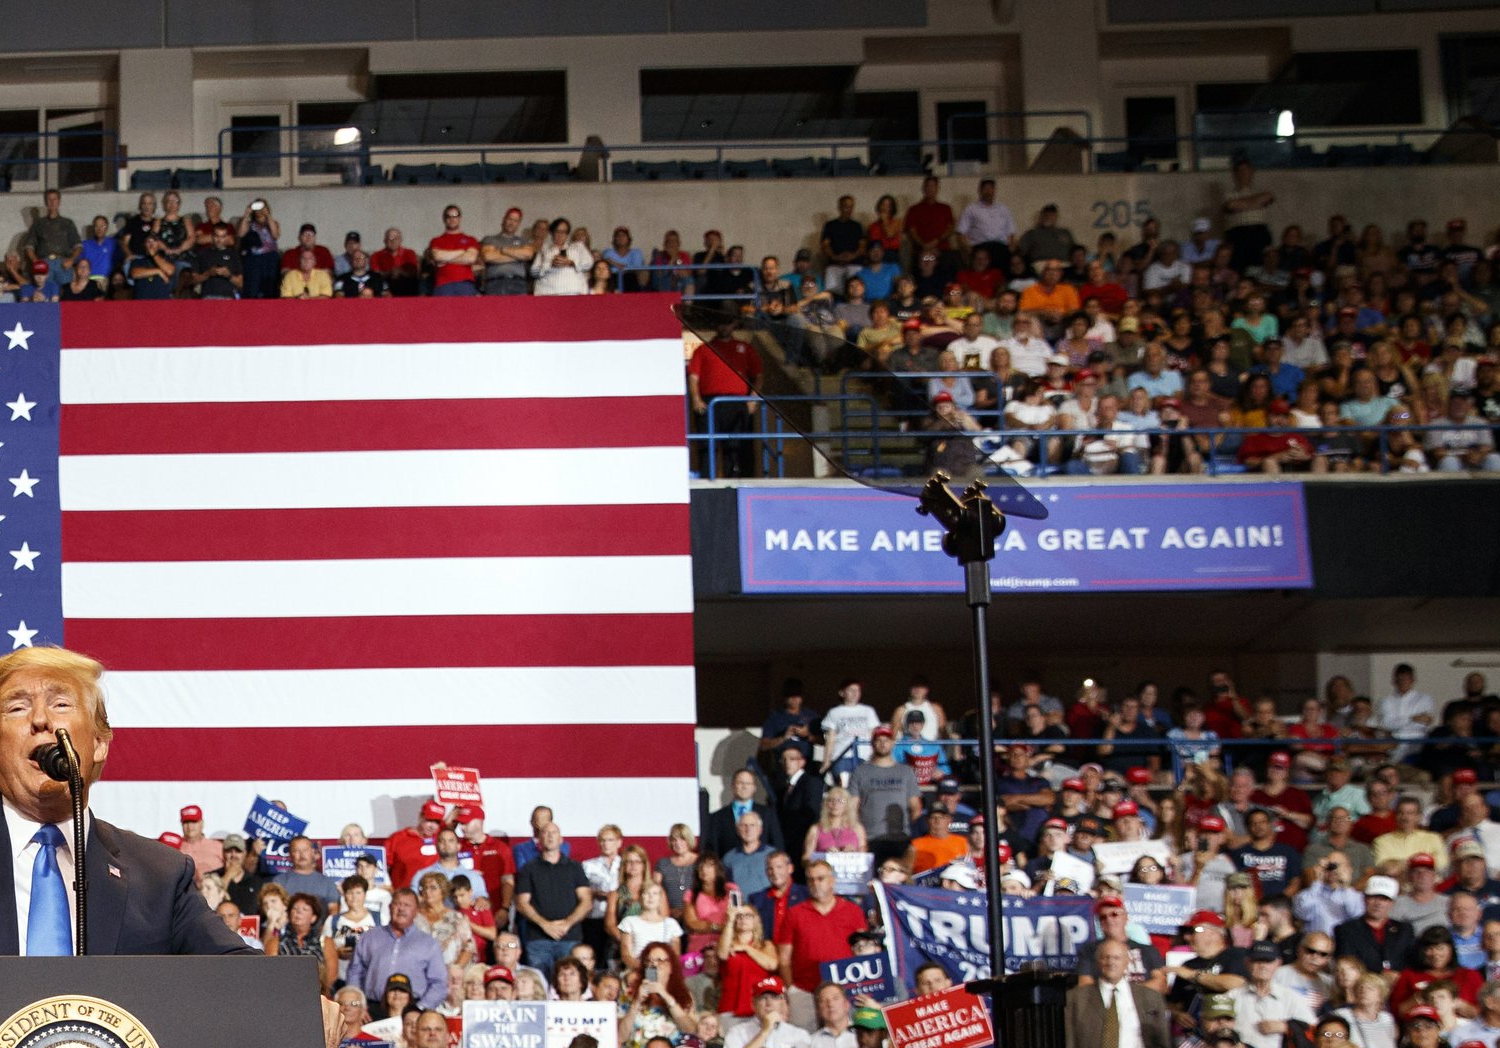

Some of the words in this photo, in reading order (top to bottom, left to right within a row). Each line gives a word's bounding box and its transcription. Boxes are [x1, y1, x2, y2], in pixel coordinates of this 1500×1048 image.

[765, 528, 859, 552] MAKE
[871, 527, 1027, 552] AMEA
[1037, 527, 1150, 551] GREAT
[1160, 524, 1284, 549] AGAIN!
[990, 577, 1079, 588] aldjtrump.com
[437, 780, 481, 794] AMERICA
[266, 808, 290, 825] KEEP
[249, 811, 299, 840] AMERIC
[265, 840, 290, 856] LO
[325, 858, 383, 871] AMEA
[896, 900, 1090, 957] TRUMP
[829, 958, 883, 985] LOU
[78, 1004, 95, 1017] OF
[99, 1009, 122, 1029] THE
[474, 1006, 538, 1022] DRAIN
[915, 1000, 949, 1018] MAKE
[493, 1022, 518, 1034] THE
[554, 1016, 608, 1025] RUMP
[895, 1005, 986, 1043] AMERICA
[943, 1023, 985, 1044] AGAIN
